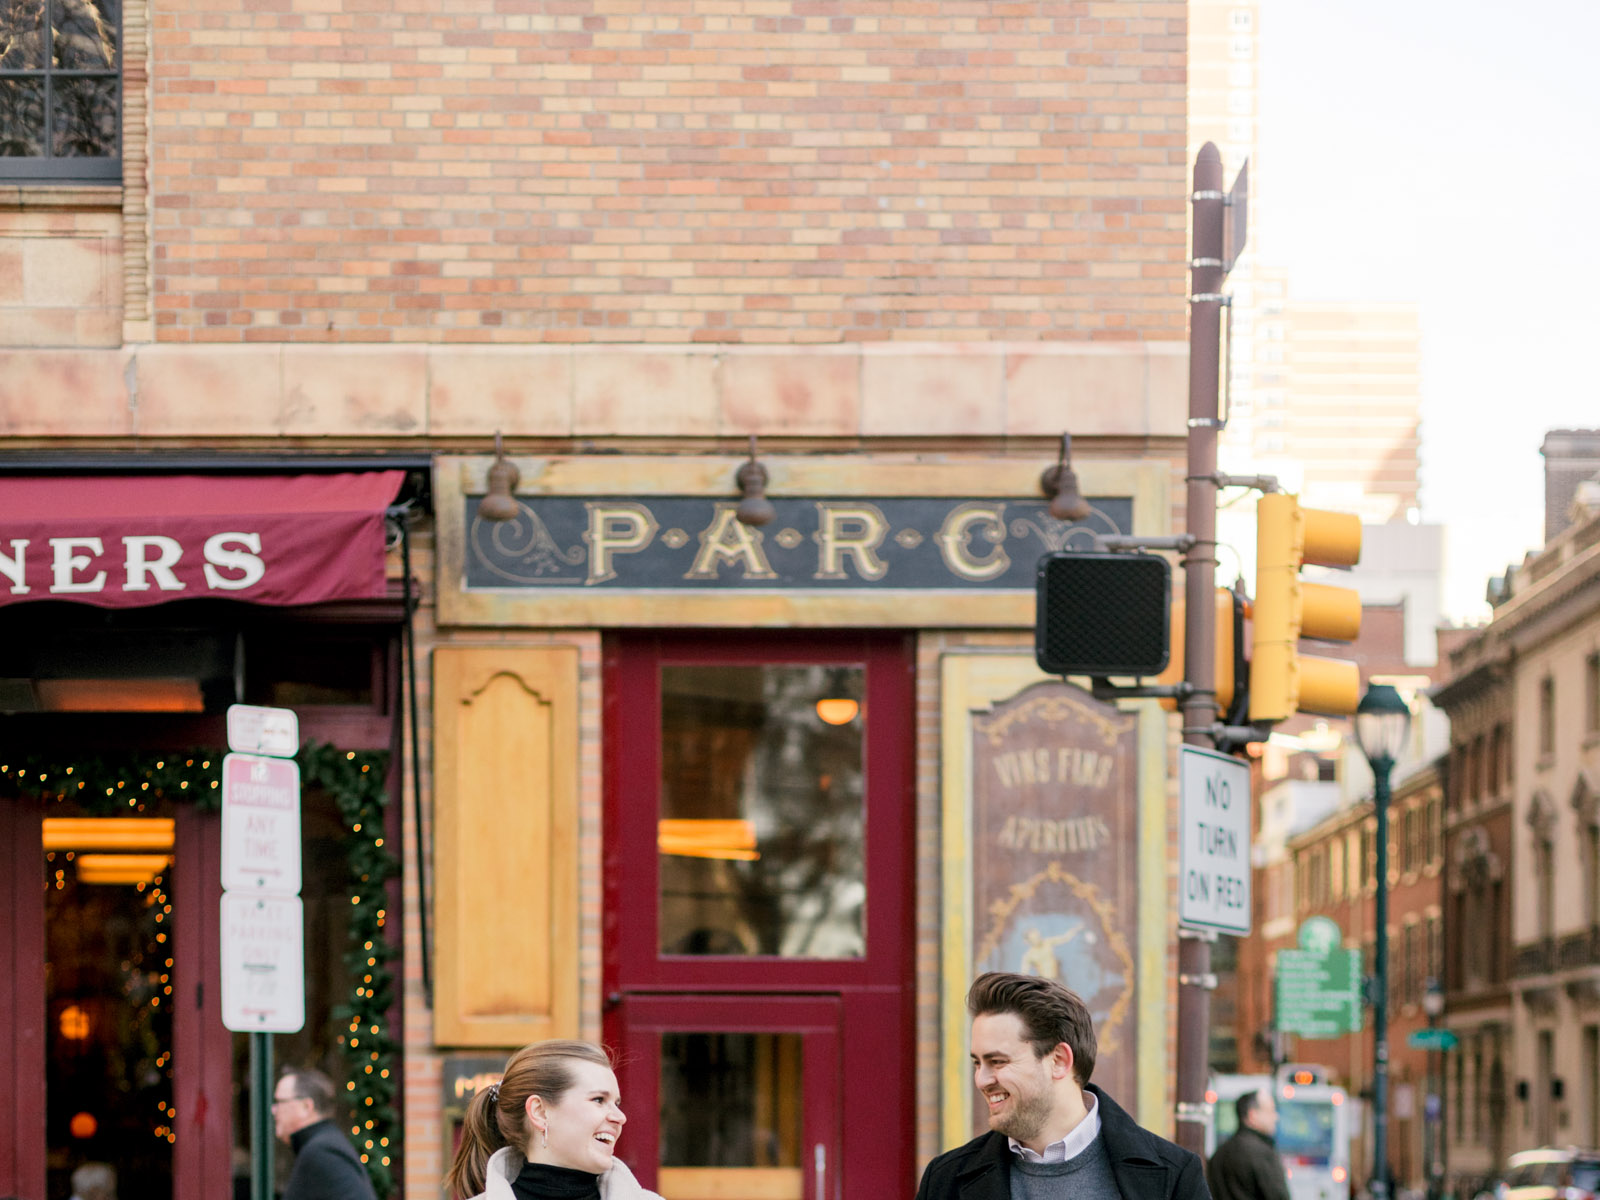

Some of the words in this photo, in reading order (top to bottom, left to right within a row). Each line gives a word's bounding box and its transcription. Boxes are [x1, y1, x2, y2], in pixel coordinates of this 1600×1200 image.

[1205, 775, 1231, 811] NO
[244, 814, 278, 835] ANY
[1198, 821, 1237, 860] TURN
[1186, 869, 1210, 902] ON
[1216, 874, 1246, 910] RED
